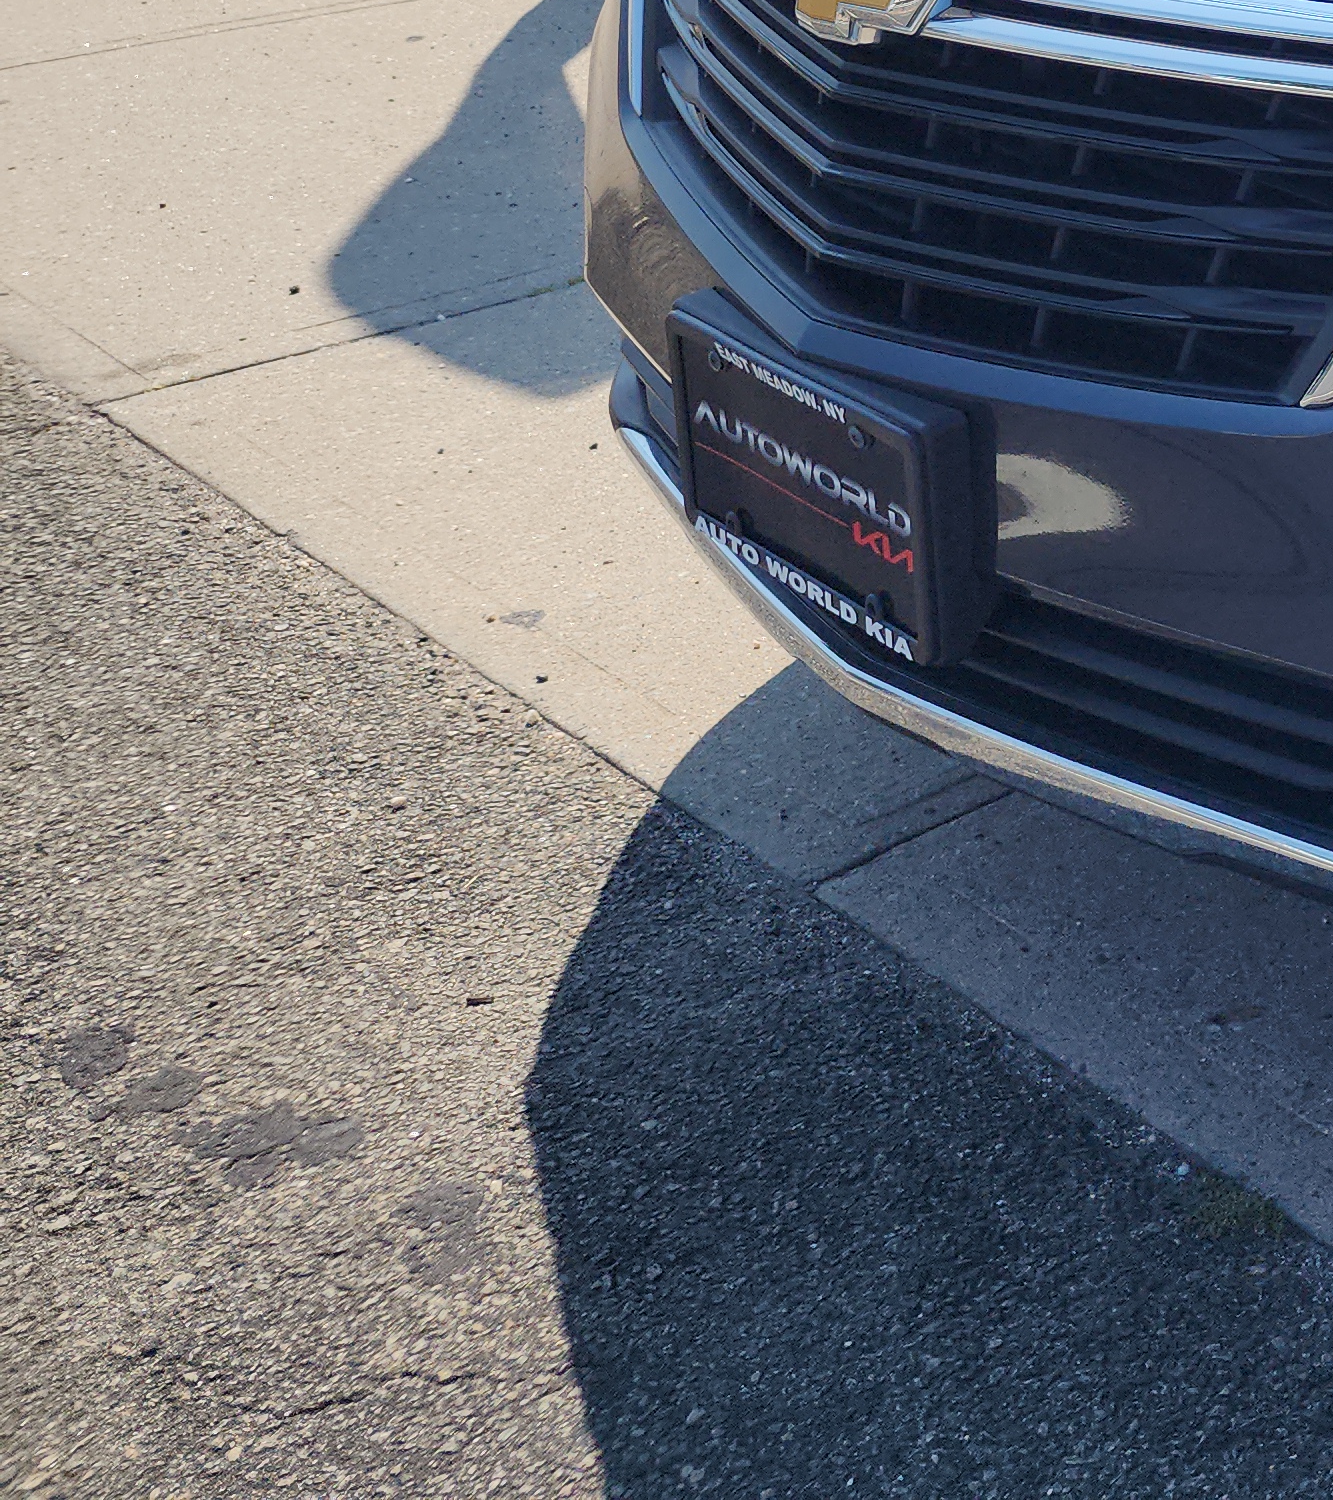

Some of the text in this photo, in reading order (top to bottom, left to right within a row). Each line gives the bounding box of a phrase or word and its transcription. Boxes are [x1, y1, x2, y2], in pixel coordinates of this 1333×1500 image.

[714, 341, 751, 374] EAST
[823, 399, 846, 424] NY
[694, 400, 911, 537] AUTOWORLD
[695, 515, 914, 661] AUTO WORLD KIA
